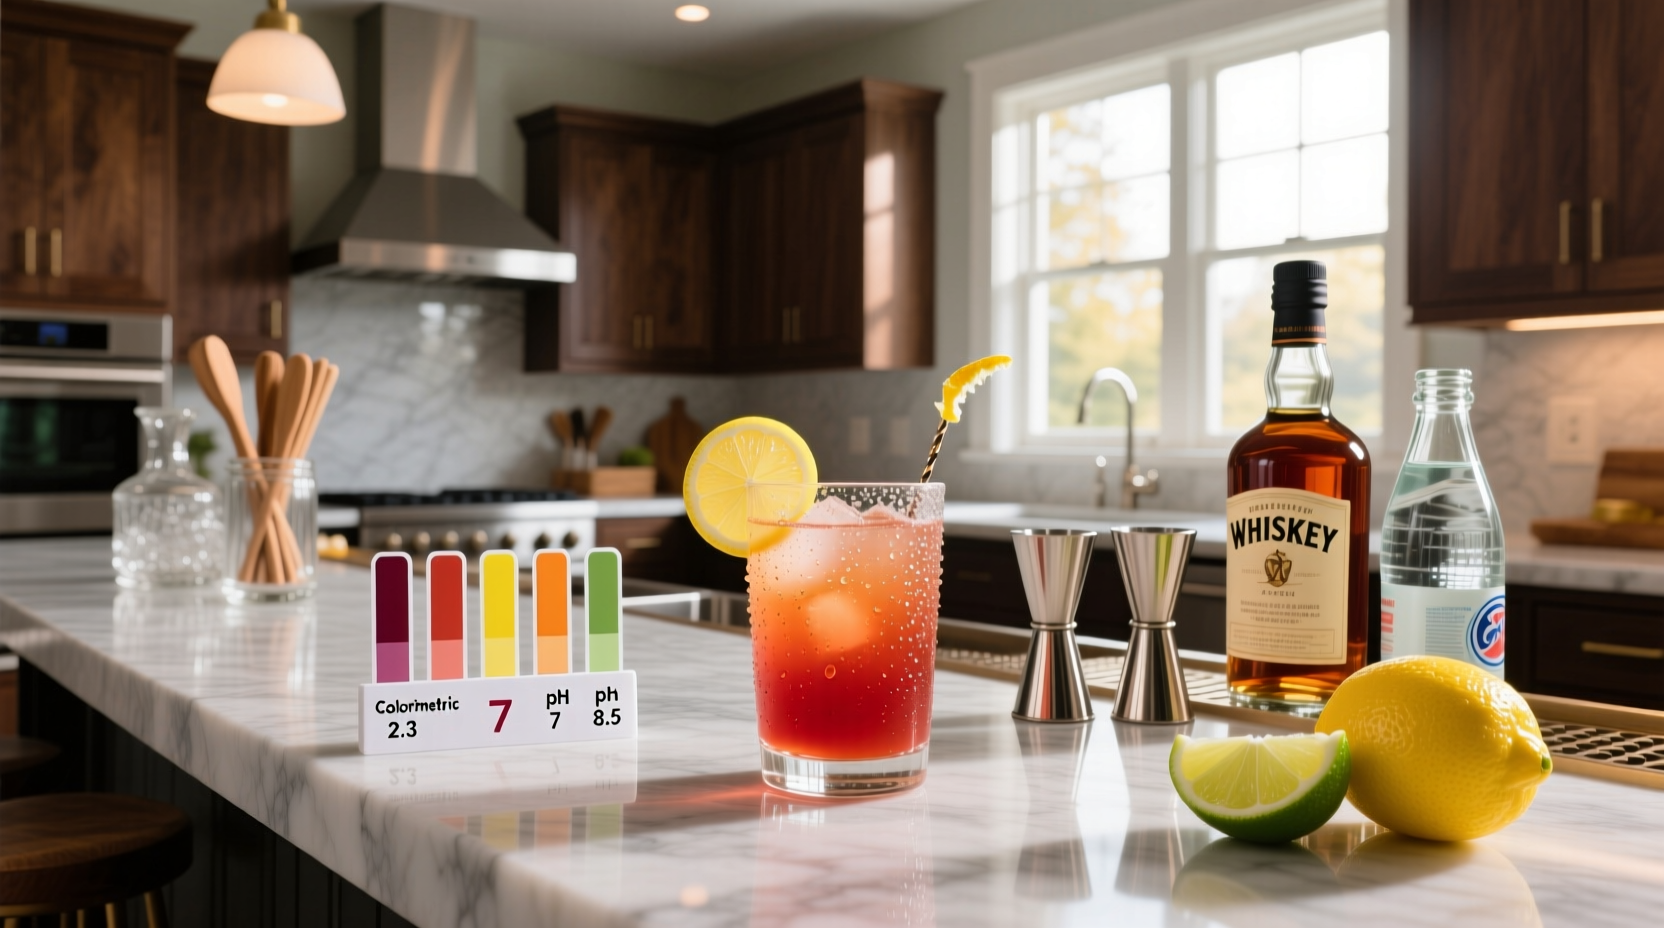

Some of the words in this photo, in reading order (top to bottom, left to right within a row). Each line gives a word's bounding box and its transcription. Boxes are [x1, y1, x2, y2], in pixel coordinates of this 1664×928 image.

[1230, 516, 1339, 553] WHISKEY
[546, 688, 570, 710] pH
[488, 699, 513, 733] 7
[549, 711, 562, 730] 7
[593, 707, 622, 727] 8.5
[387, 720, 418, 739] 2.3
